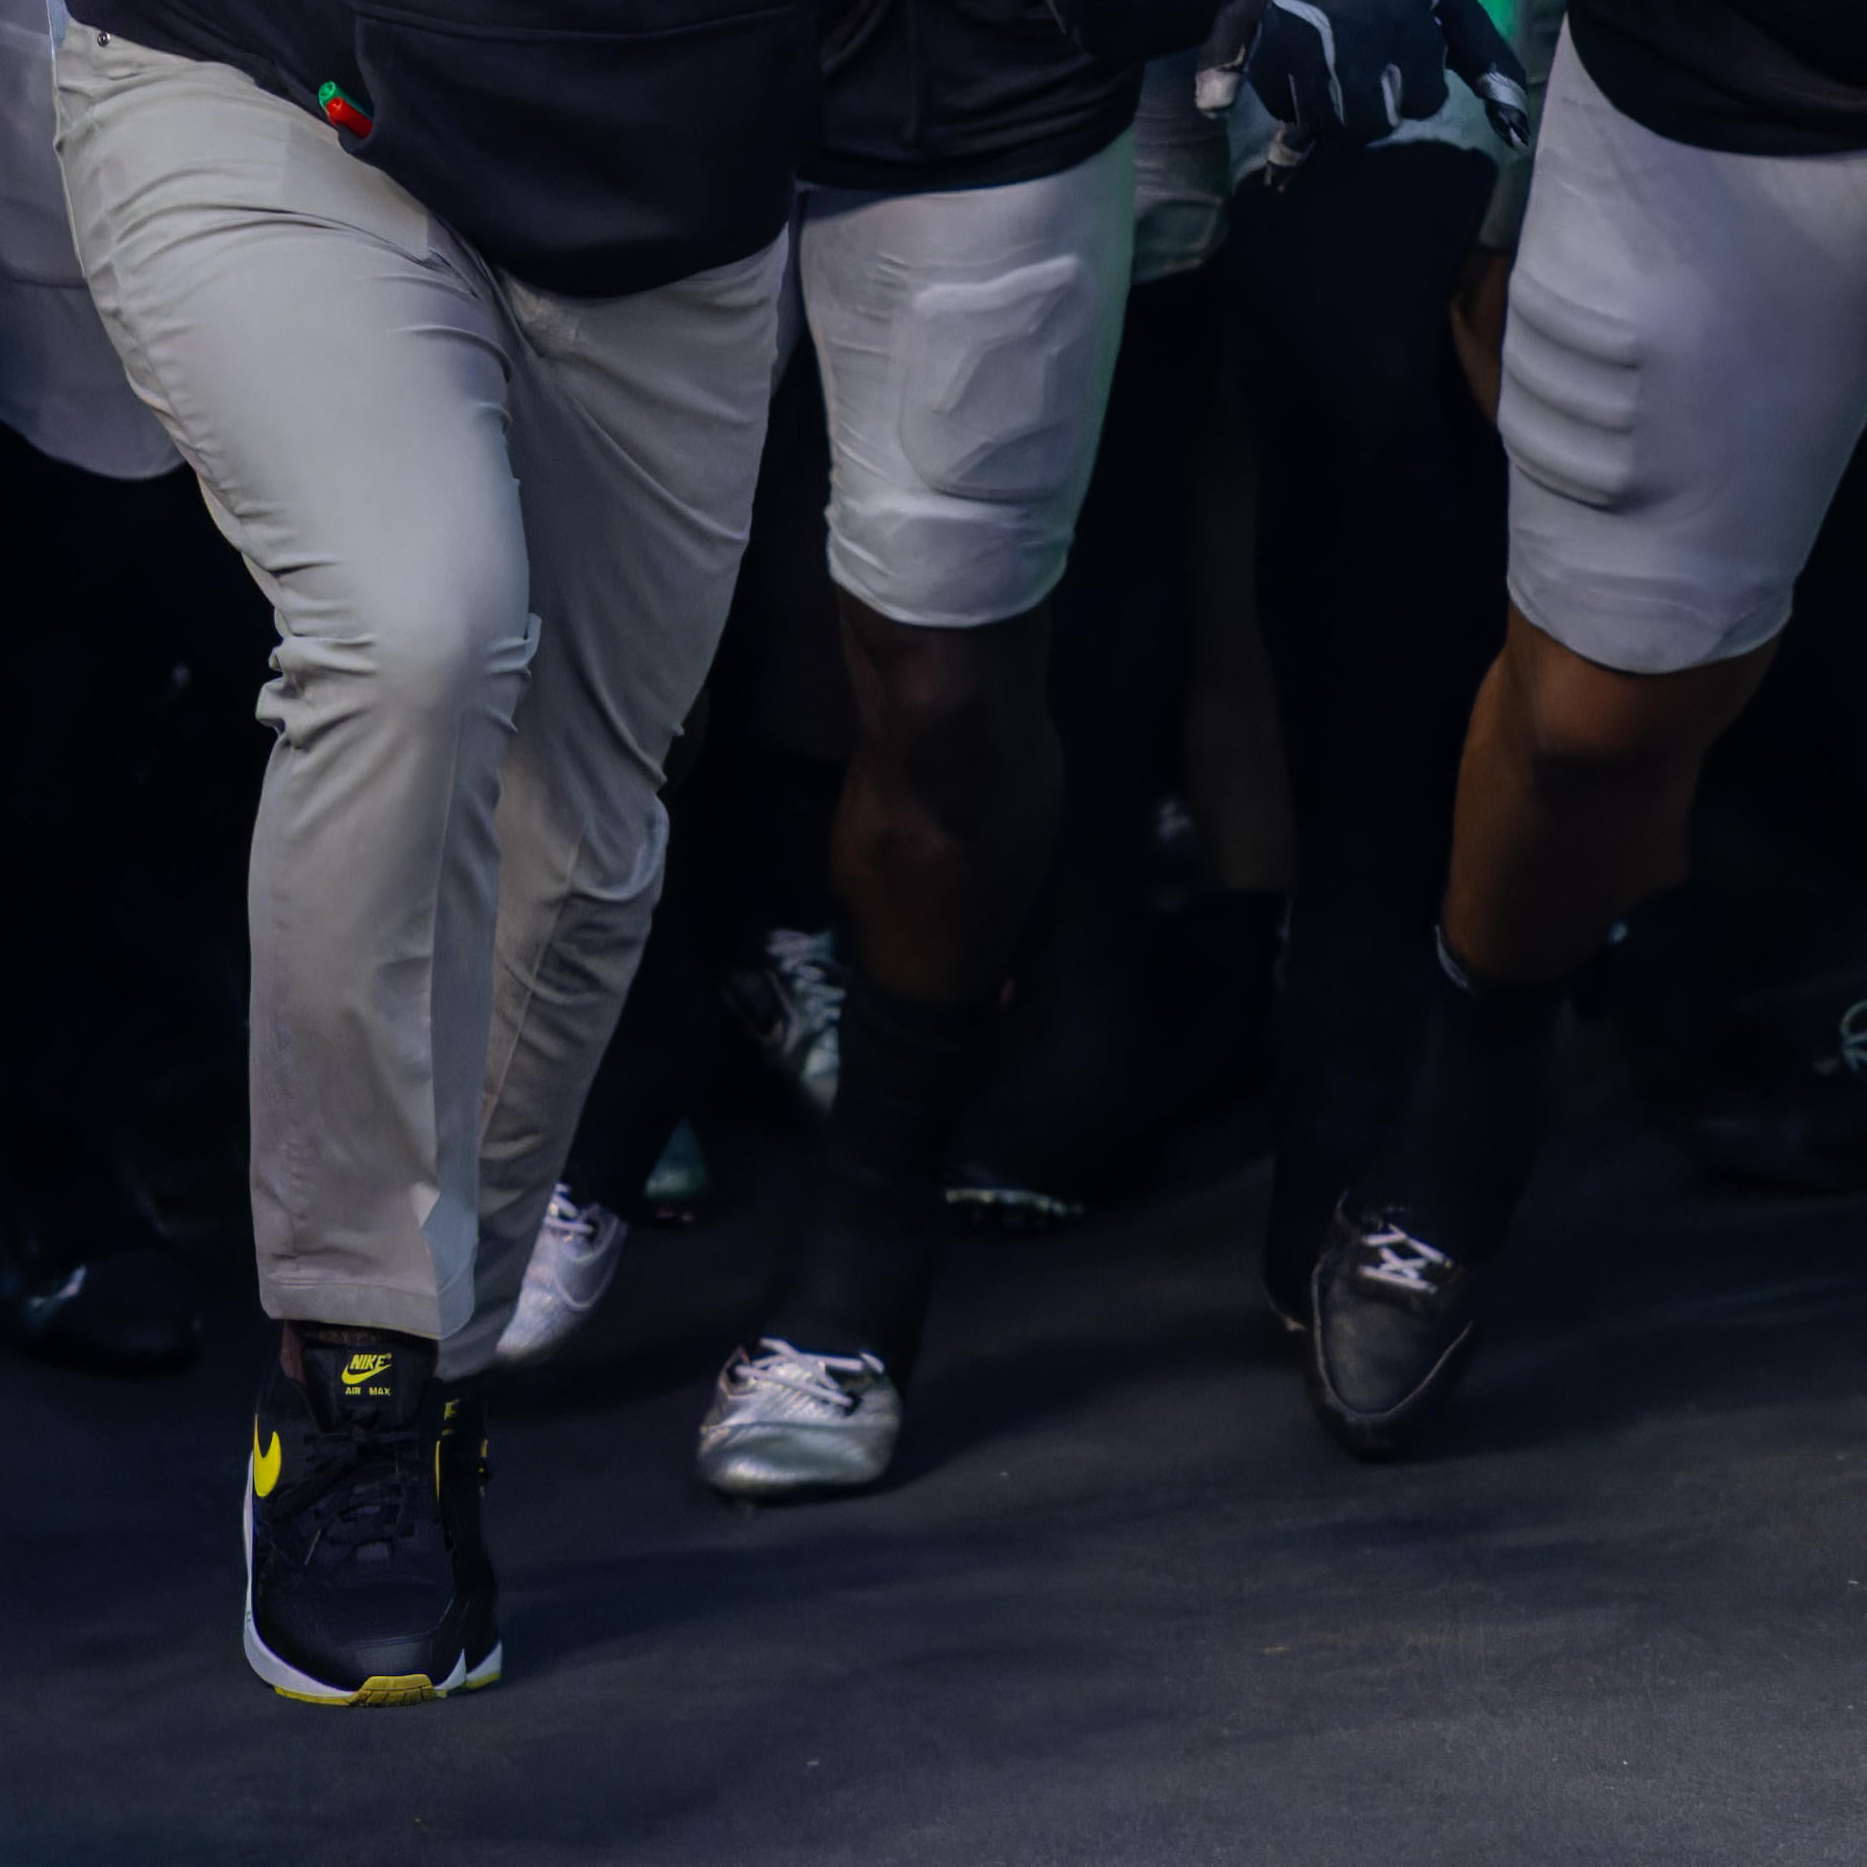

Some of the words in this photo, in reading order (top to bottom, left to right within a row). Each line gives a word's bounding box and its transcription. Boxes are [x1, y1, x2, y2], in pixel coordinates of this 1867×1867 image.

[349, 1353, 387, 1371] NIKE
[345, 1386, 362, 1396] AIR
[369, 1386, 392, 1396] MAX
